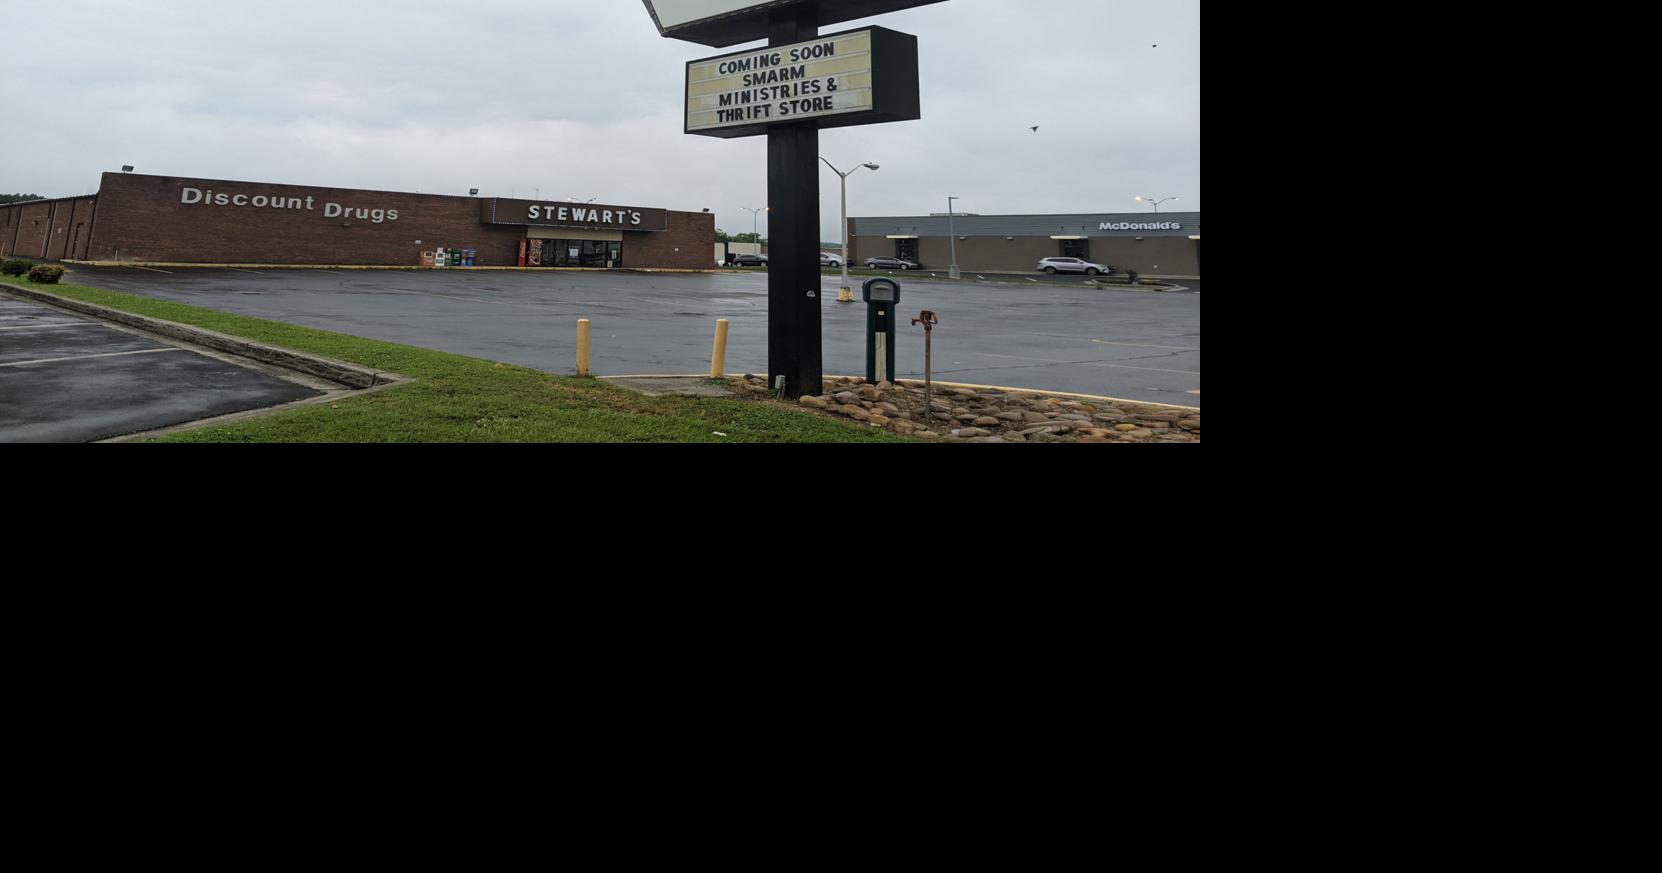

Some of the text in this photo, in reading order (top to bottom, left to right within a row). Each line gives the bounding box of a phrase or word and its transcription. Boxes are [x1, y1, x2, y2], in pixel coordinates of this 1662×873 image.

[718, 42, 835, 75] COMING SOON
[742, 65, 805, 87] SMARM
[718, 77, 837, 107] MINISTRIES &
[716, 95, 833, 123] THRIFT STORE
[180, 187, 399, 224] Discount Drugs
[527, 205, 641, 225] STEWART'S
[1099, 221, 1181, 231] McDonald's
